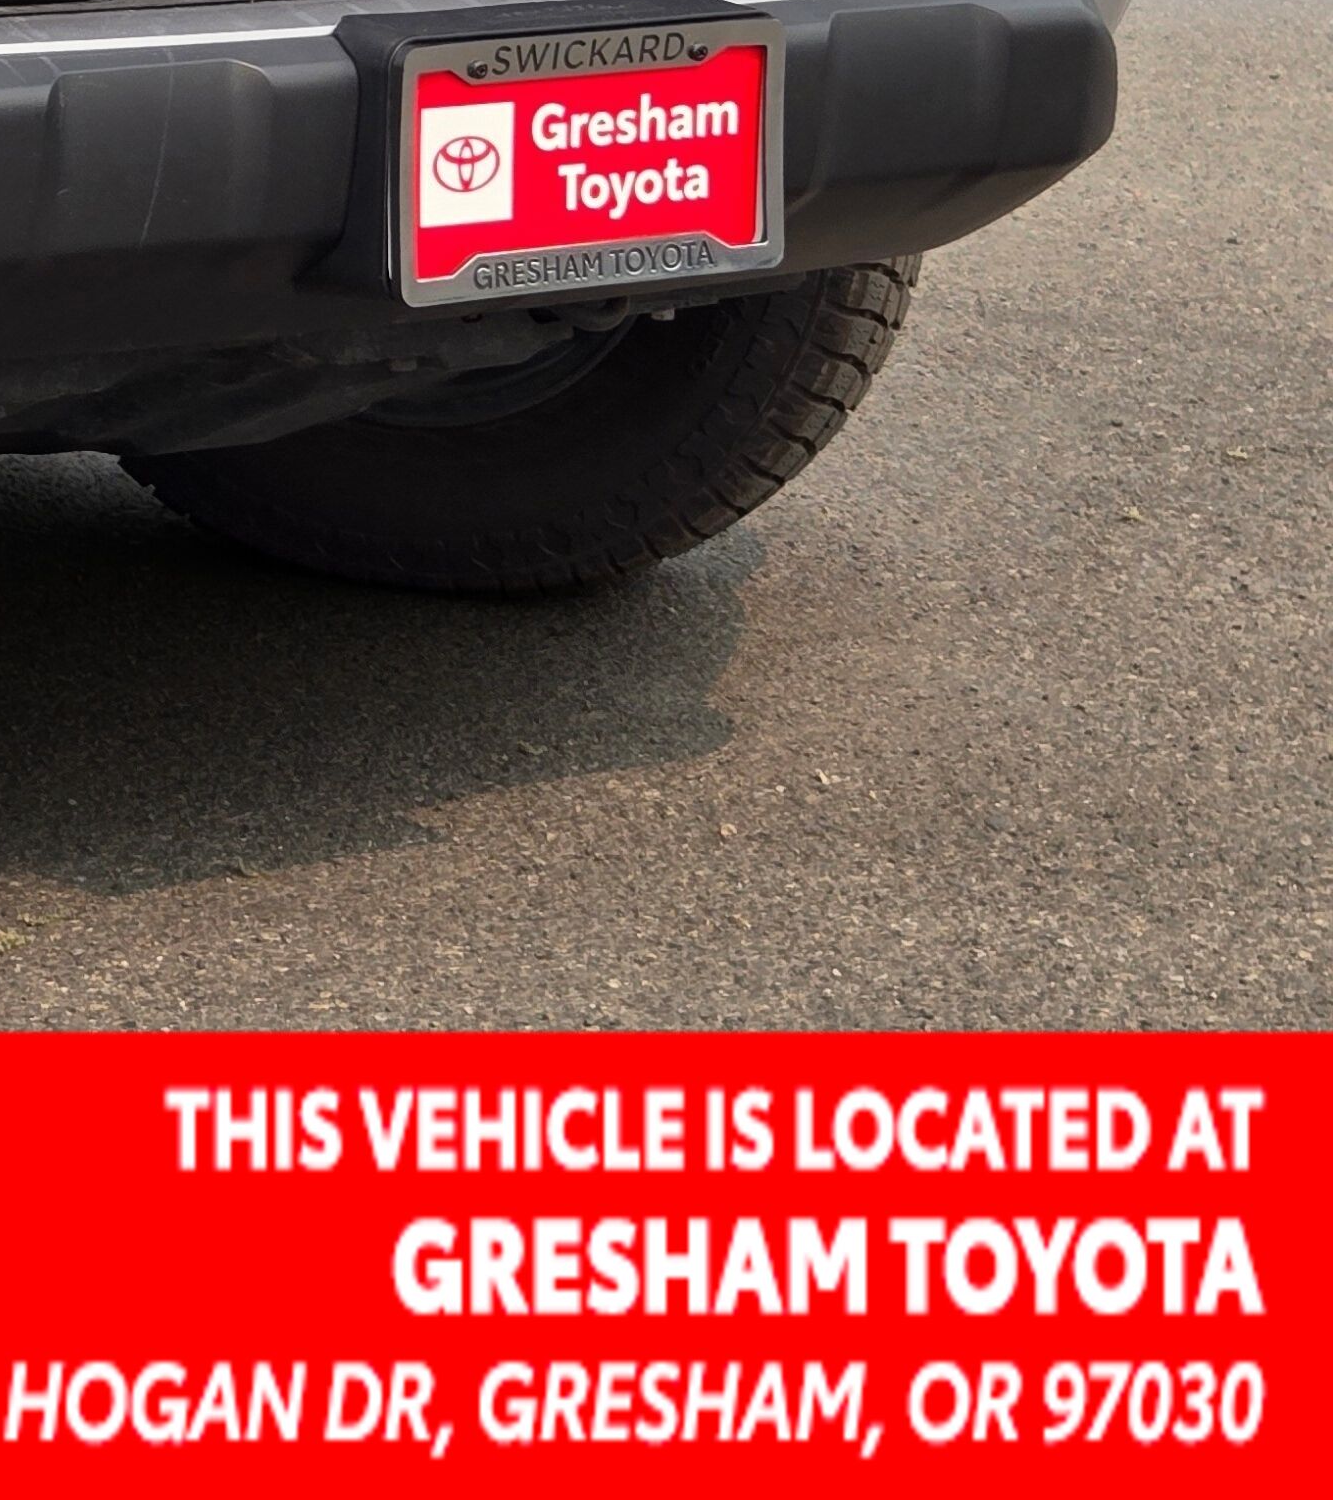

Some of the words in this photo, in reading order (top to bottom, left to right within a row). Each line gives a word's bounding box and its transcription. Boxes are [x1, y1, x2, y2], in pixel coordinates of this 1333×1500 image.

[490, 31, 687, 77] SWICKARD
[530, 93, 739, 152] Gresham
[557, 157, 710, 220] Toyota
[473, 249, 605, 292] GRESHAM
[608, 238, 715, 276] TOYOTA
